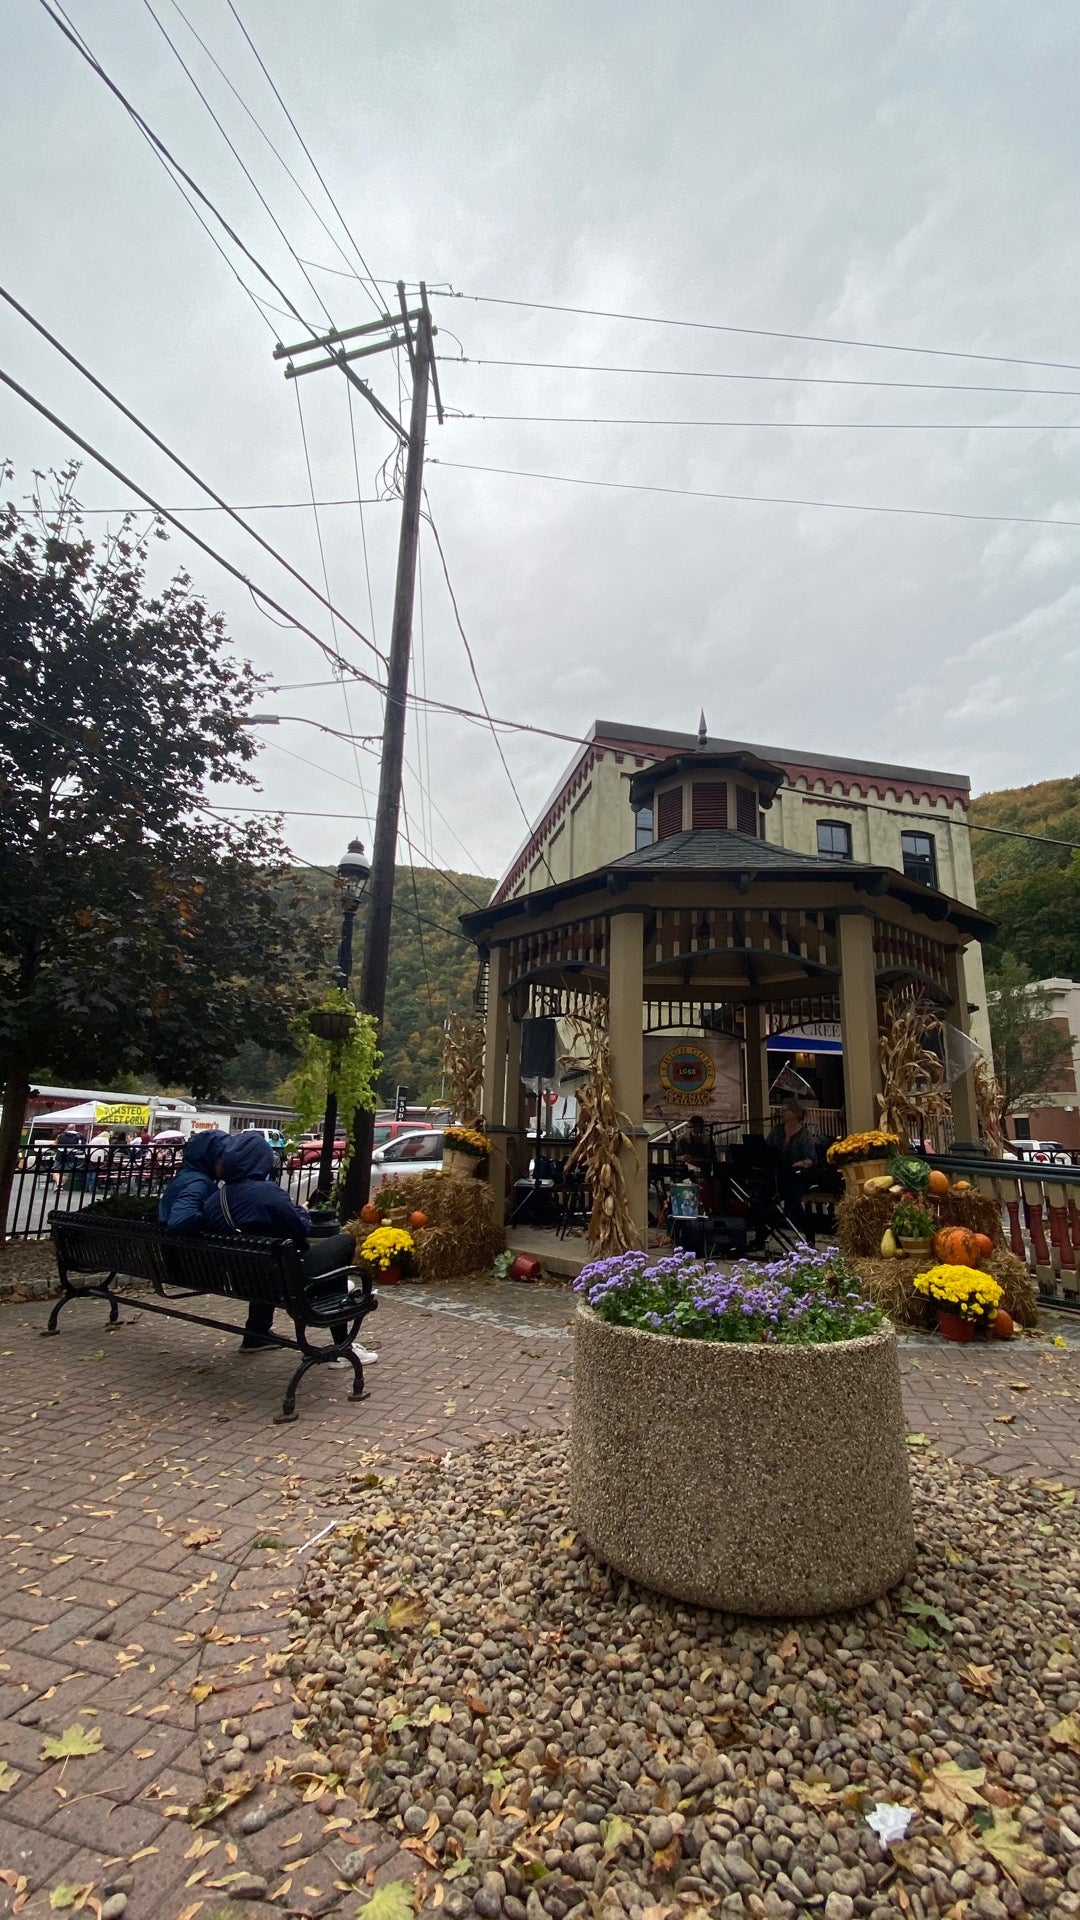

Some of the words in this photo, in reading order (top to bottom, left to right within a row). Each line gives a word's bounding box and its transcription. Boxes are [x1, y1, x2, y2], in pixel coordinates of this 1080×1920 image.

[691, 1048, 714, 1079] GORGE
[104, 1106, 142, 1115] ROASTED
[125, 1116, 145, 1125] CORN
[191, 1120, 219, 1130] Tommy's
